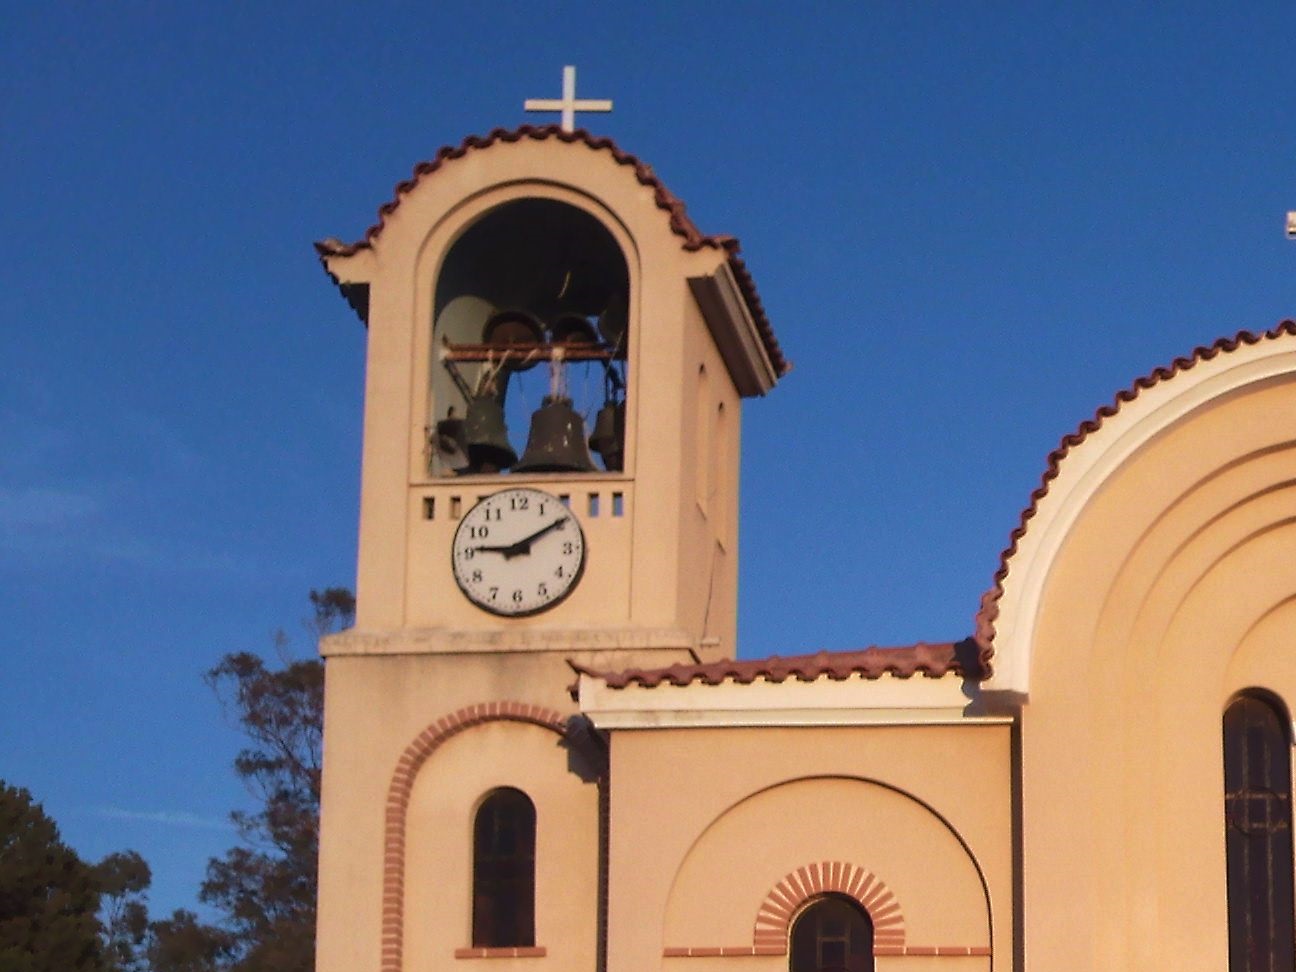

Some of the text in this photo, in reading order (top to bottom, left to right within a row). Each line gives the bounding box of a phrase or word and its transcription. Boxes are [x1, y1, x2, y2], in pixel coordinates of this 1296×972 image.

[510, 497, 528, 511] 12
[539, 503, 544, 516] 1
[484, 508, 501, 521] 11
[470, 526, 488, 539] 10
[464, 547, 474, 560] 9
[563, 543, 572, 555] 3
[472, 570, 482, 583] 8
[555, 566, 563, 578] 4
[489, 587, 499, 600] 7
[512, 590, 523, 602] 6
[538, 583, 547, 596] 5
